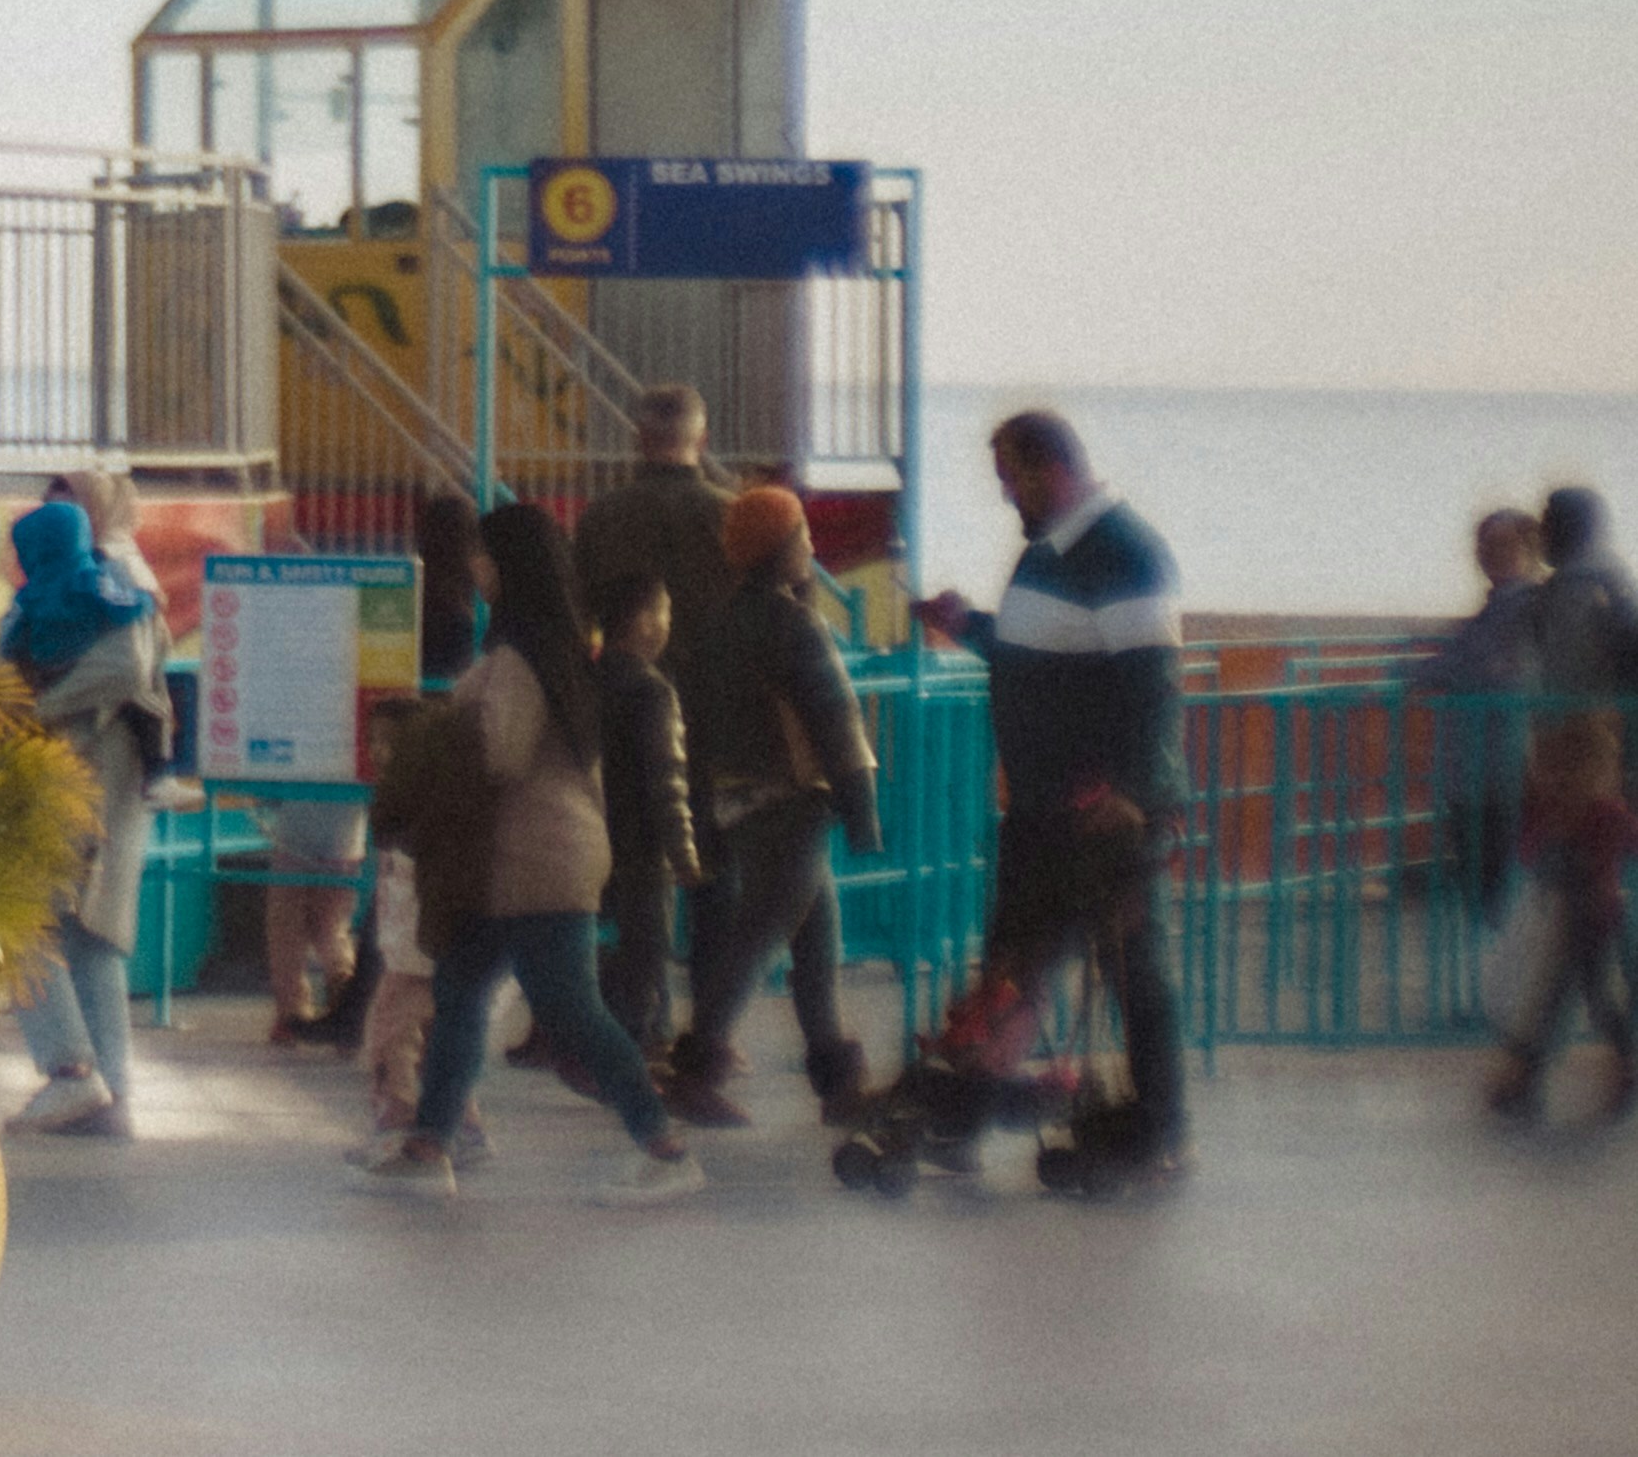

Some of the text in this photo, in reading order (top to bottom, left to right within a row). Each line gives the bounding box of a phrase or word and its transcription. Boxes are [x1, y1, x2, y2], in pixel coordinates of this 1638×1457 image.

[652, 161, 833, 186] SEA SWINGS
[564, 185, 594, 225] 6
